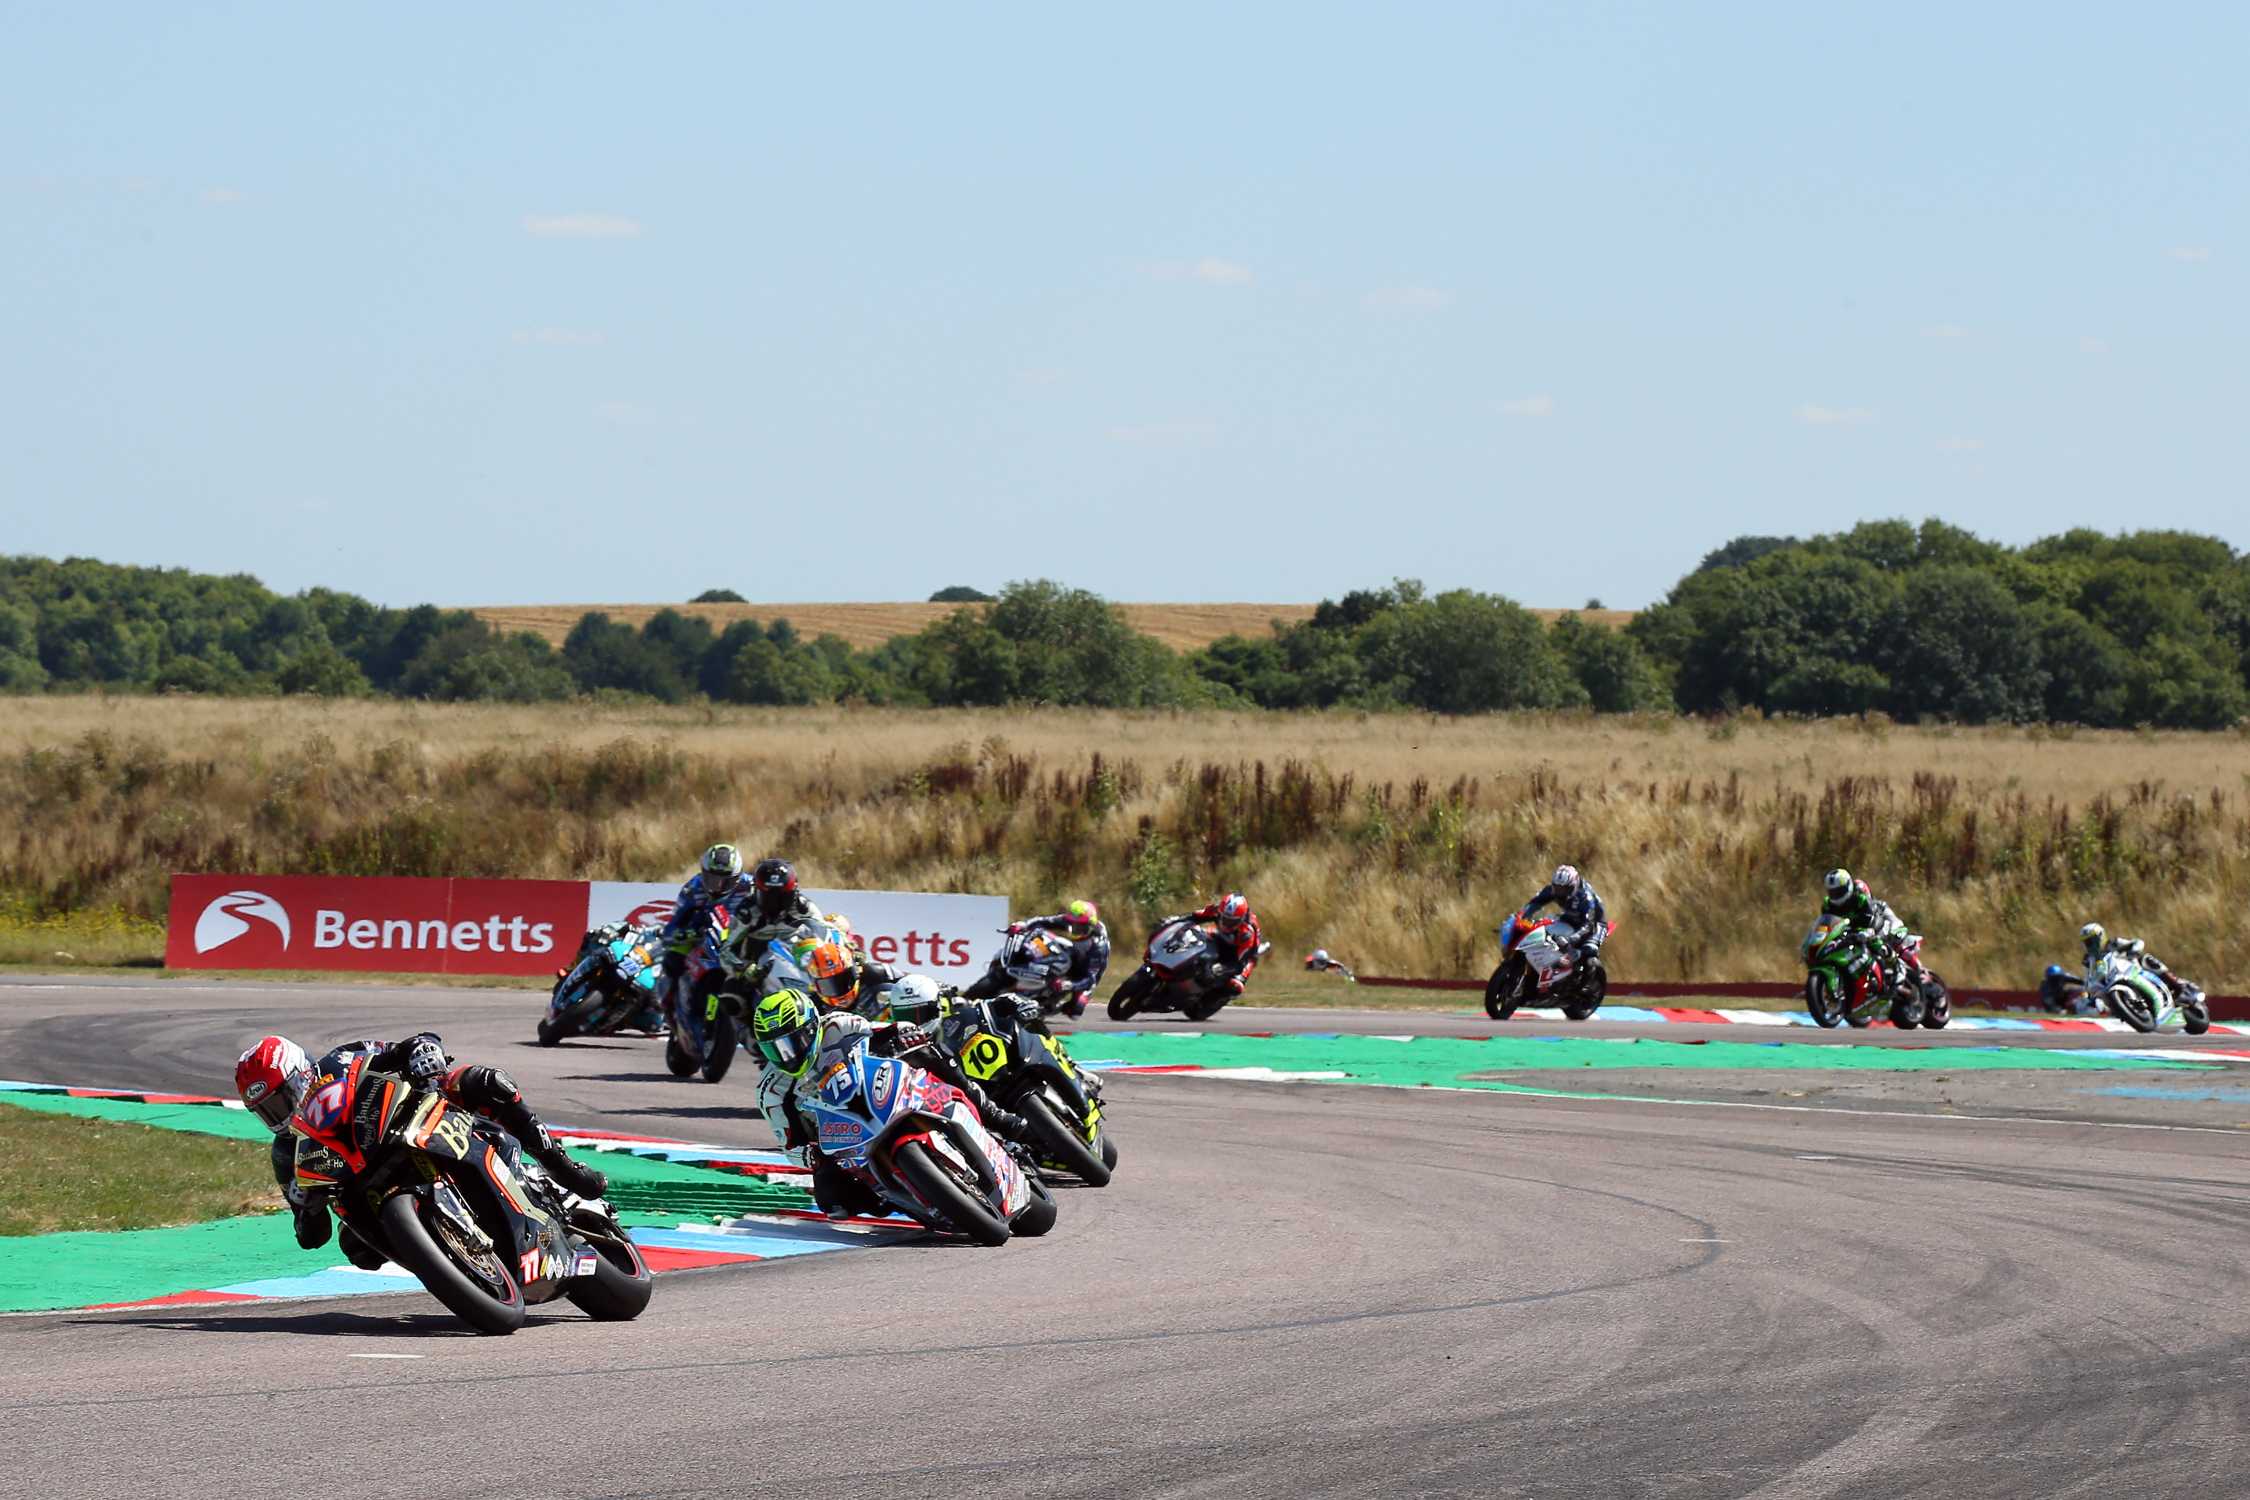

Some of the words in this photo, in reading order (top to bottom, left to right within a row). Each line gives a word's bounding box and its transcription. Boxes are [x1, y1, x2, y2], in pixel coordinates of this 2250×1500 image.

[314, 909, 554, 953] Bennetts
[969, 1039, 999, 1076] 10
[247, 1082, 266, 1098] Arai
[825, 1067, 853, 1100] 75
[305, 1081, 344, 1128] 77
[520, 1248, 539, 1284] 77
